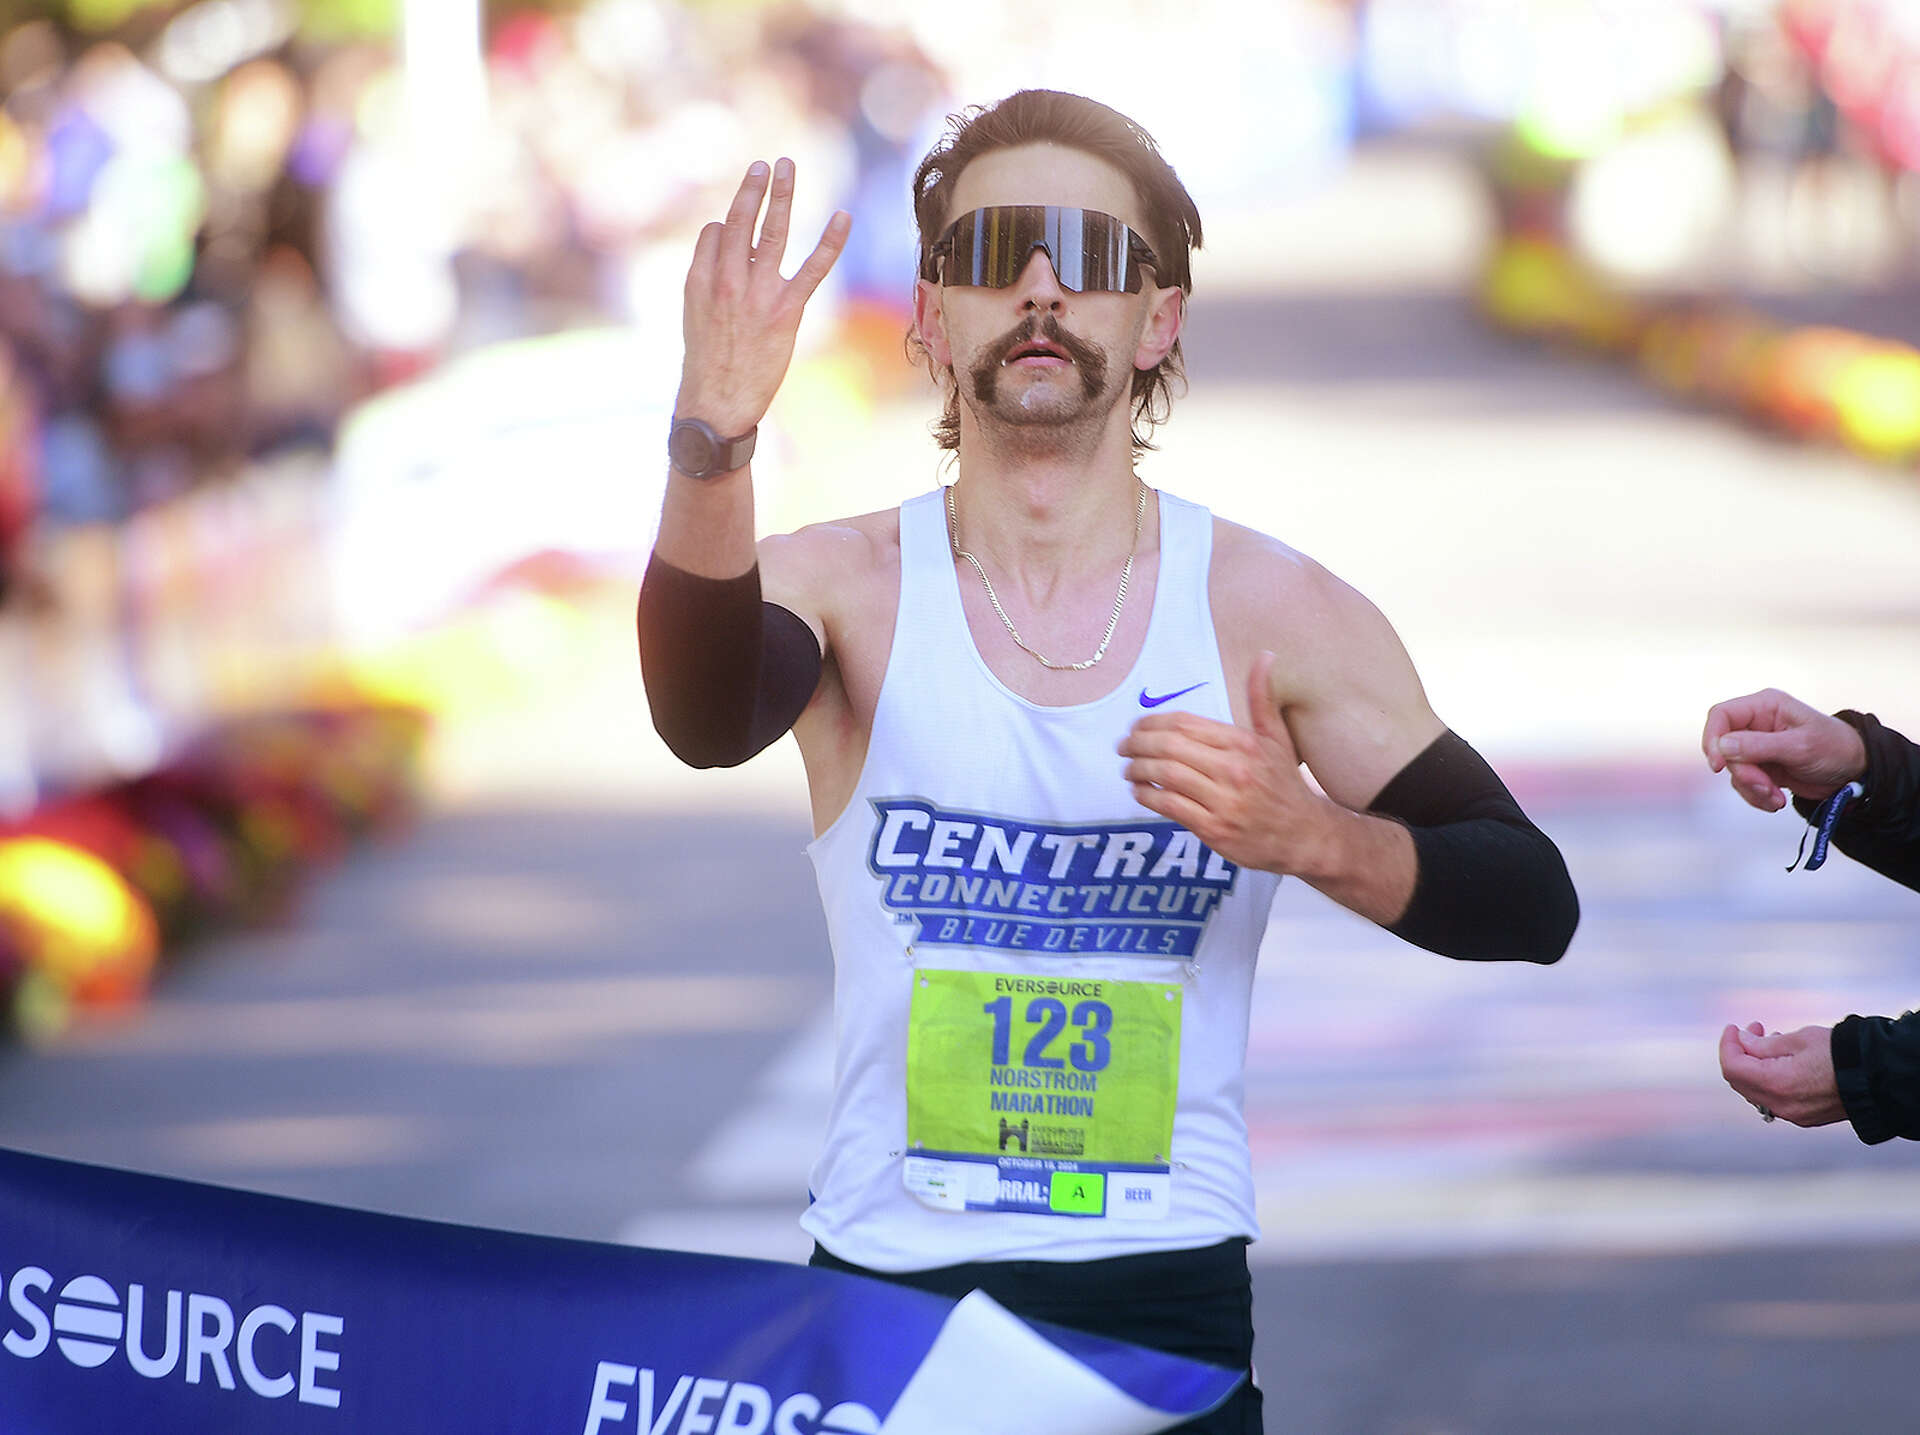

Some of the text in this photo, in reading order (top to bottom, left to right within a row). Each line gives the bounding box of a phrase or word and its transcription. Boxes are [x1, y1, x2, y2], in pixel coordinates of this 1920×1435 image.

[876, 809, 1234, 881] CENTRAL
[889, 873, 1221, 914] CONNECTICUT
[938, 917, 1181, 953] BLUE DEVILS
[995, 978, 1103, 998] EVERSOURCE
[983, 995, 1114, 1073] 123
[990, 1068, 1097, 1093] NORSTROM
[990, 1091, 1094, 1117] MARATHON
[998, 1178, 1049, 1205] RRAL:
[1071, 1185, 1085, 1199] A
[0, 1265, 344, 1409] SOURCE
